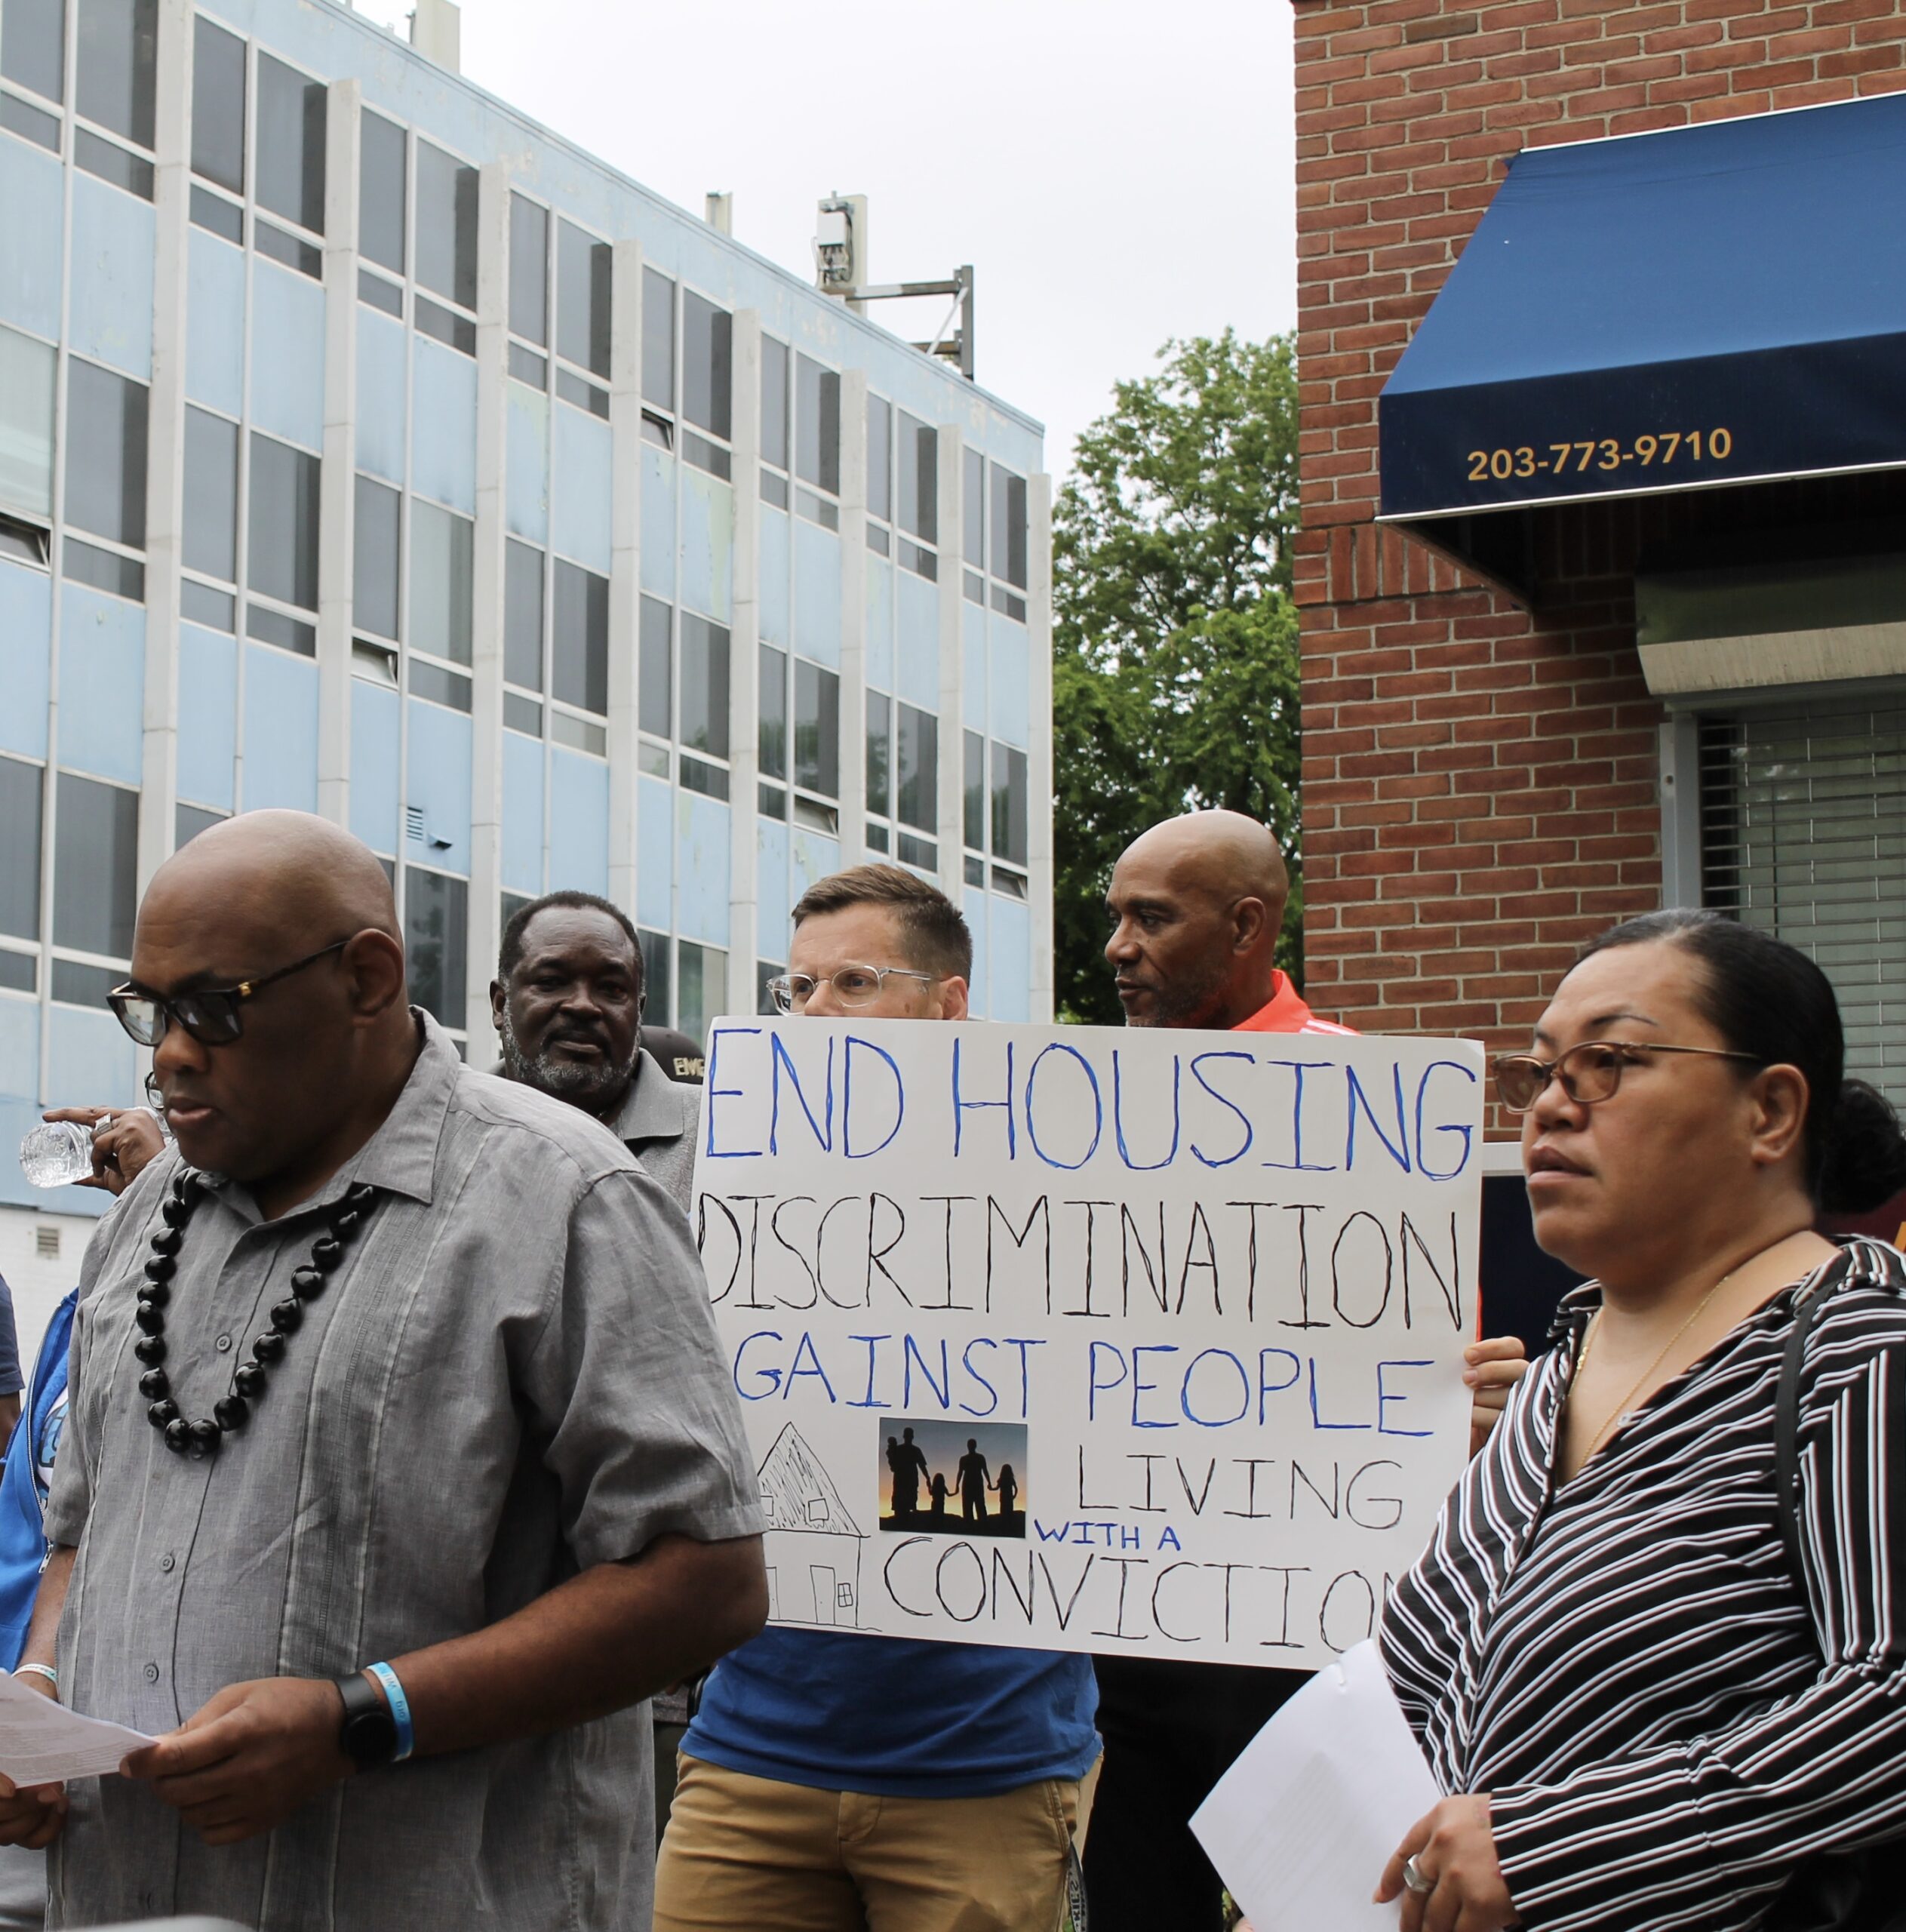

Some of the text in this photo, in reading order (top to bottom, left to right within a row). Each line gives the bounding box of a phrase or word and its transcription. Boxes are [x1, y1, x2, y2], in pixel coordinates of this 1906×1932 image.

[1468, 427, 1732, 481] 203-773-9710
[706, 1029, 1477, 1182] END HOUSING
[697, 1192, 1462, 1333] DISCRIMINATION
[733, 1331, 1435, 1437] GAINST PEOPLE
[1034, 1518, 1182, 1552] WITH A
[1079, 1444, 1403, 1529] LIVING
[883, 1536, 1394, 1654] CONVICTIO
